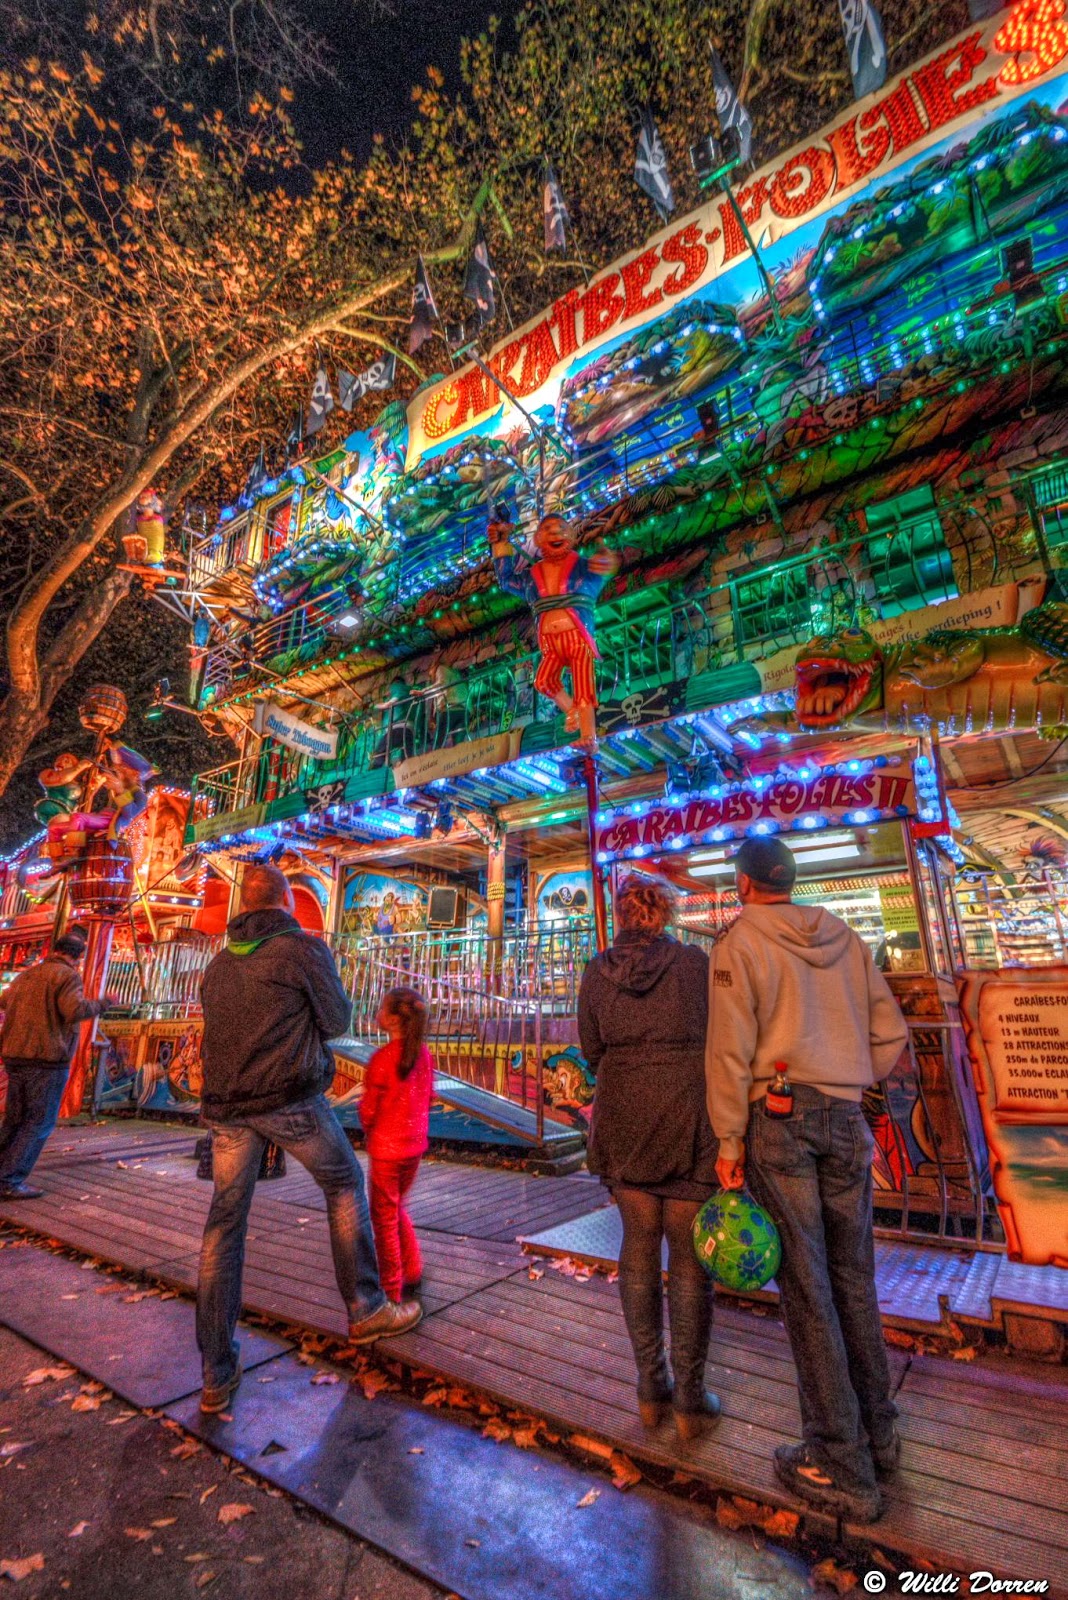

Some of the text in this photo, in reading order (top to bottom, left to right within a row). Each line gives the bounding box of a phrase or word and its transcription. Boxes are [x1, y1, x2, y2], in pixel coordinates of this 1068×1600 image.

[926, 605, 992, 634] verdieping
[875, 626, 905, 641] tages
[764, 664, 795, 682] Rigola
[266, 714, 291, 737] Super
[1006, 1014, 1040, 1023] NIVEAUX
[1001, 1027, 1011, 1036] 13
[1022, 1027, 1060, 1036] HAUTEUR
[1003, 1041, 1014, 1050] 28
[1006, 1055, 1028, 1063] 250m
[1008, 1087, 1059, 1099] ATTRACTION
